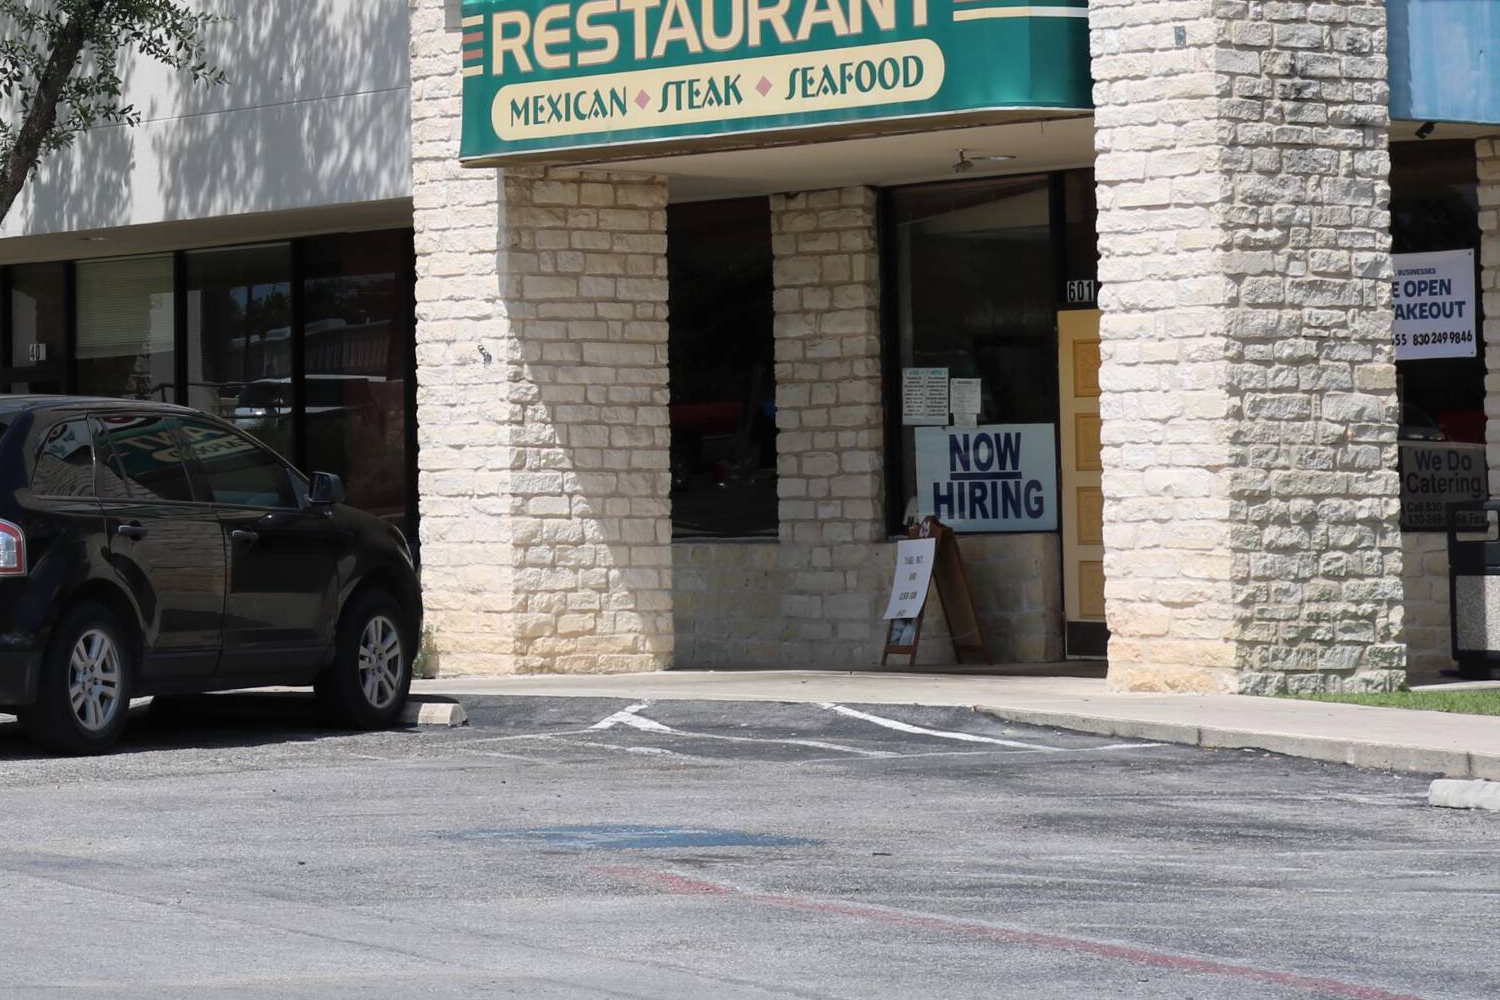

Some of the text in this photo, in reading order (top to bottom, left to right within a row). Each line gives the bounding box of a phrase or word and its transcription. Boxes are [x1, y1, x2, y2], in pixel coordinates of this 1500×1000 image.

[509, 54, 925, 128] MEXICAN STEAK SEAFOOD
[1397, 268, 1436, 276] BUSINESSES
[1068, 280, 1094, 302] 601
[1403, 279, 1452, 297] OPEN
[948, 432, 1022, 472] NOW
[1414, 449, 1472, 471] We Do
[932, 479, 1045, 520] HIRING
